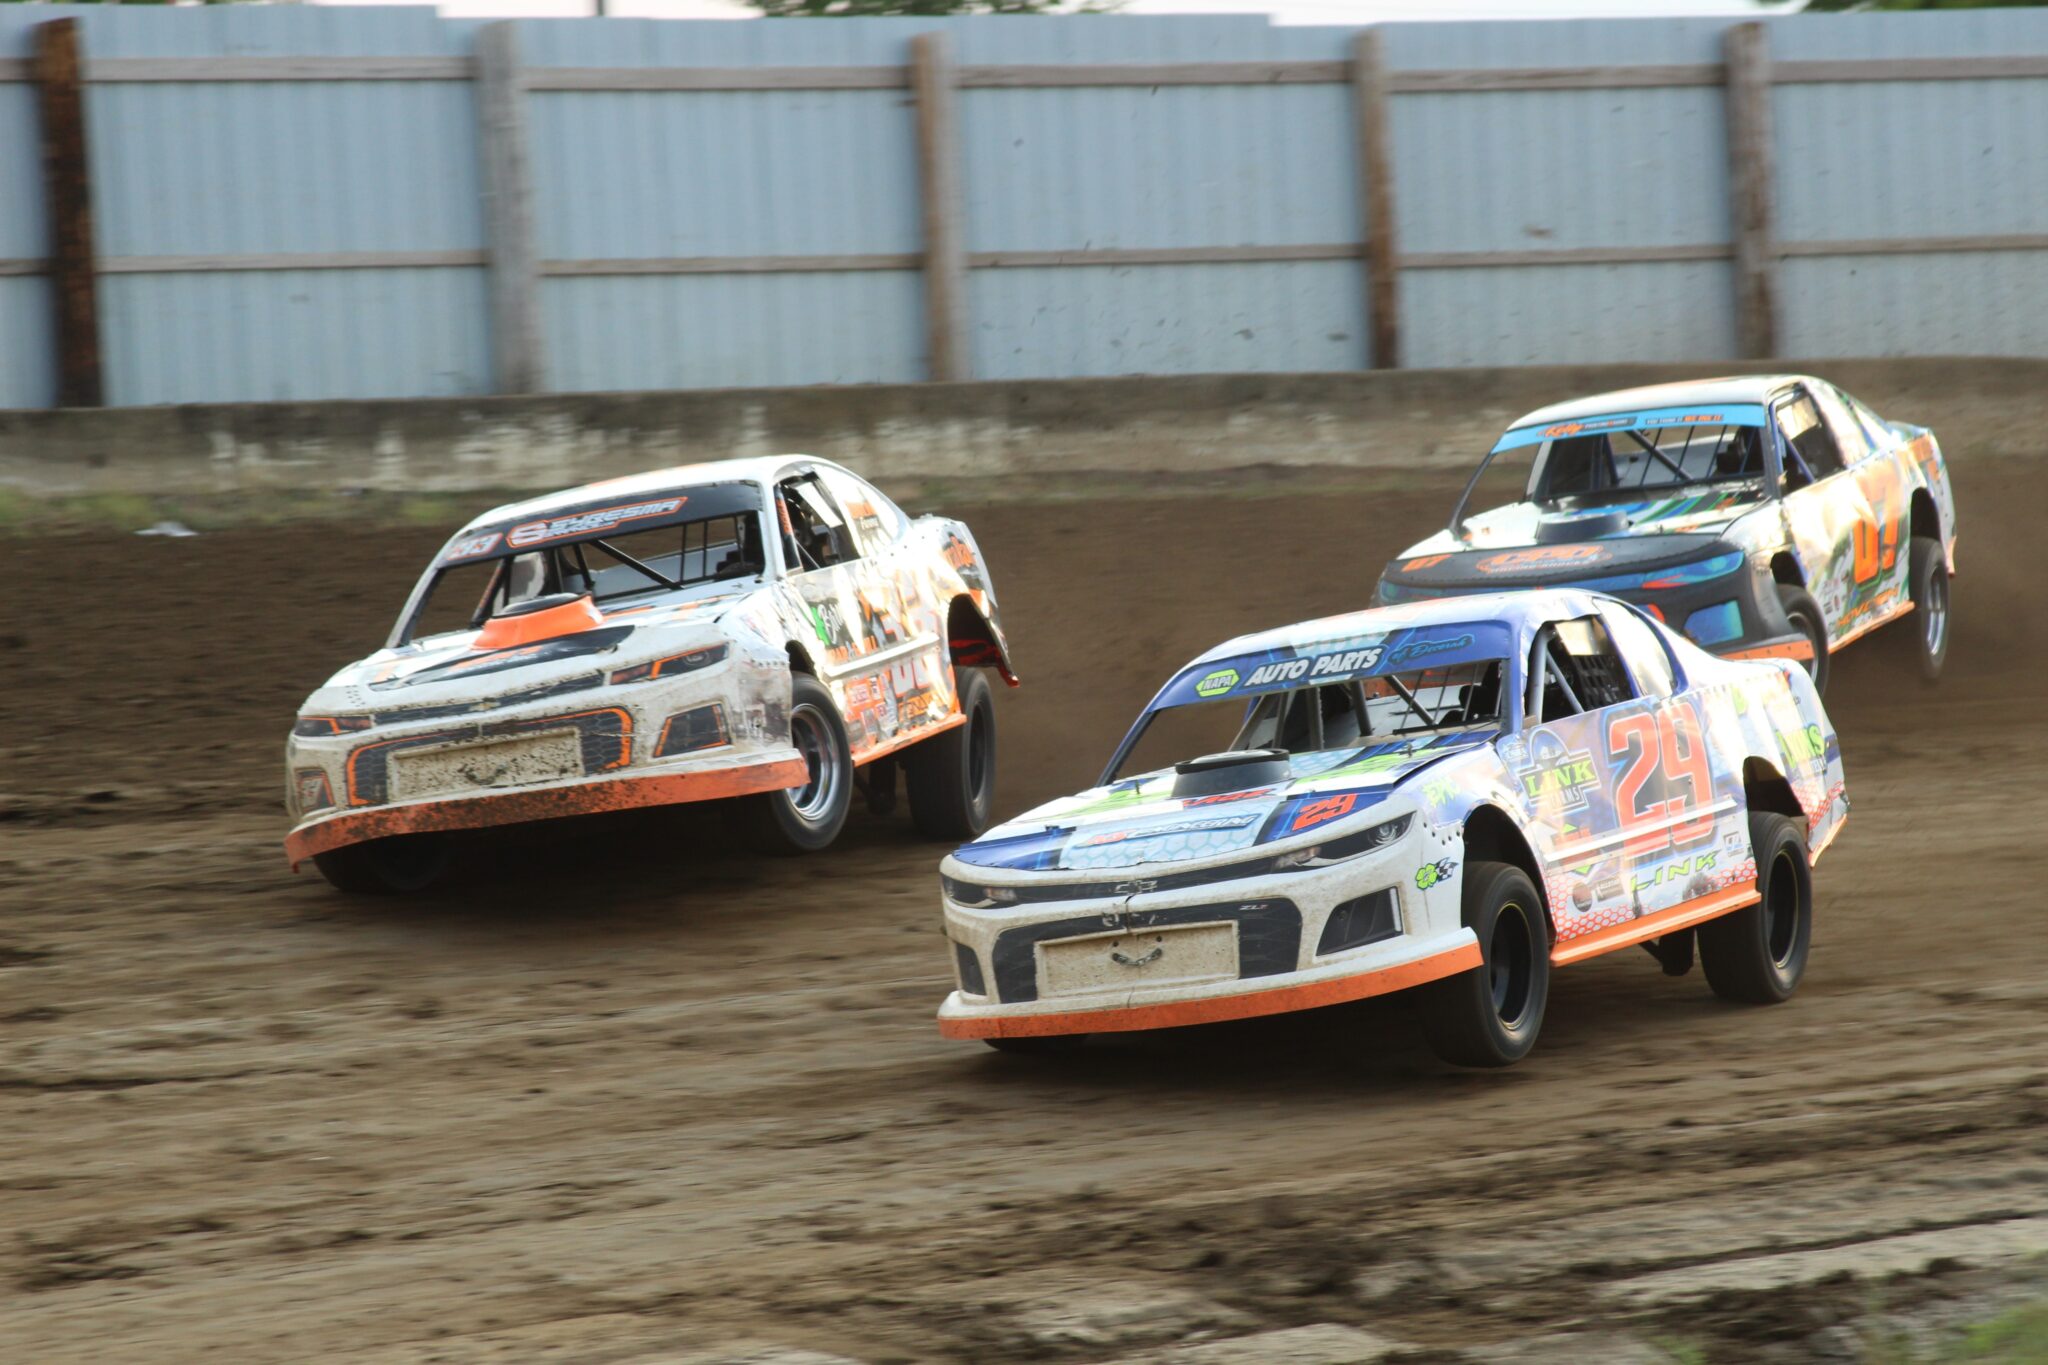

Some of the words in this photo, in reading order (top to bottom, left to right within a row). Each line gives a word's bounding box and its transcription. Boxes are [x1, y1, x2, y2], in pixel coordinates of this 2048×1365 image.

[1202, 675, 1234, 690] NAPA
[1244, 659, 1310, 687] AUTO
[1310, 648, 1383, 676] PARTS
[1525, 760, 1596, 798] LINK
[1609, 702, 1714, 859] 29
[1291, 793, 1358, 831] 29
[1630, 849, 1721, 893] LINK
